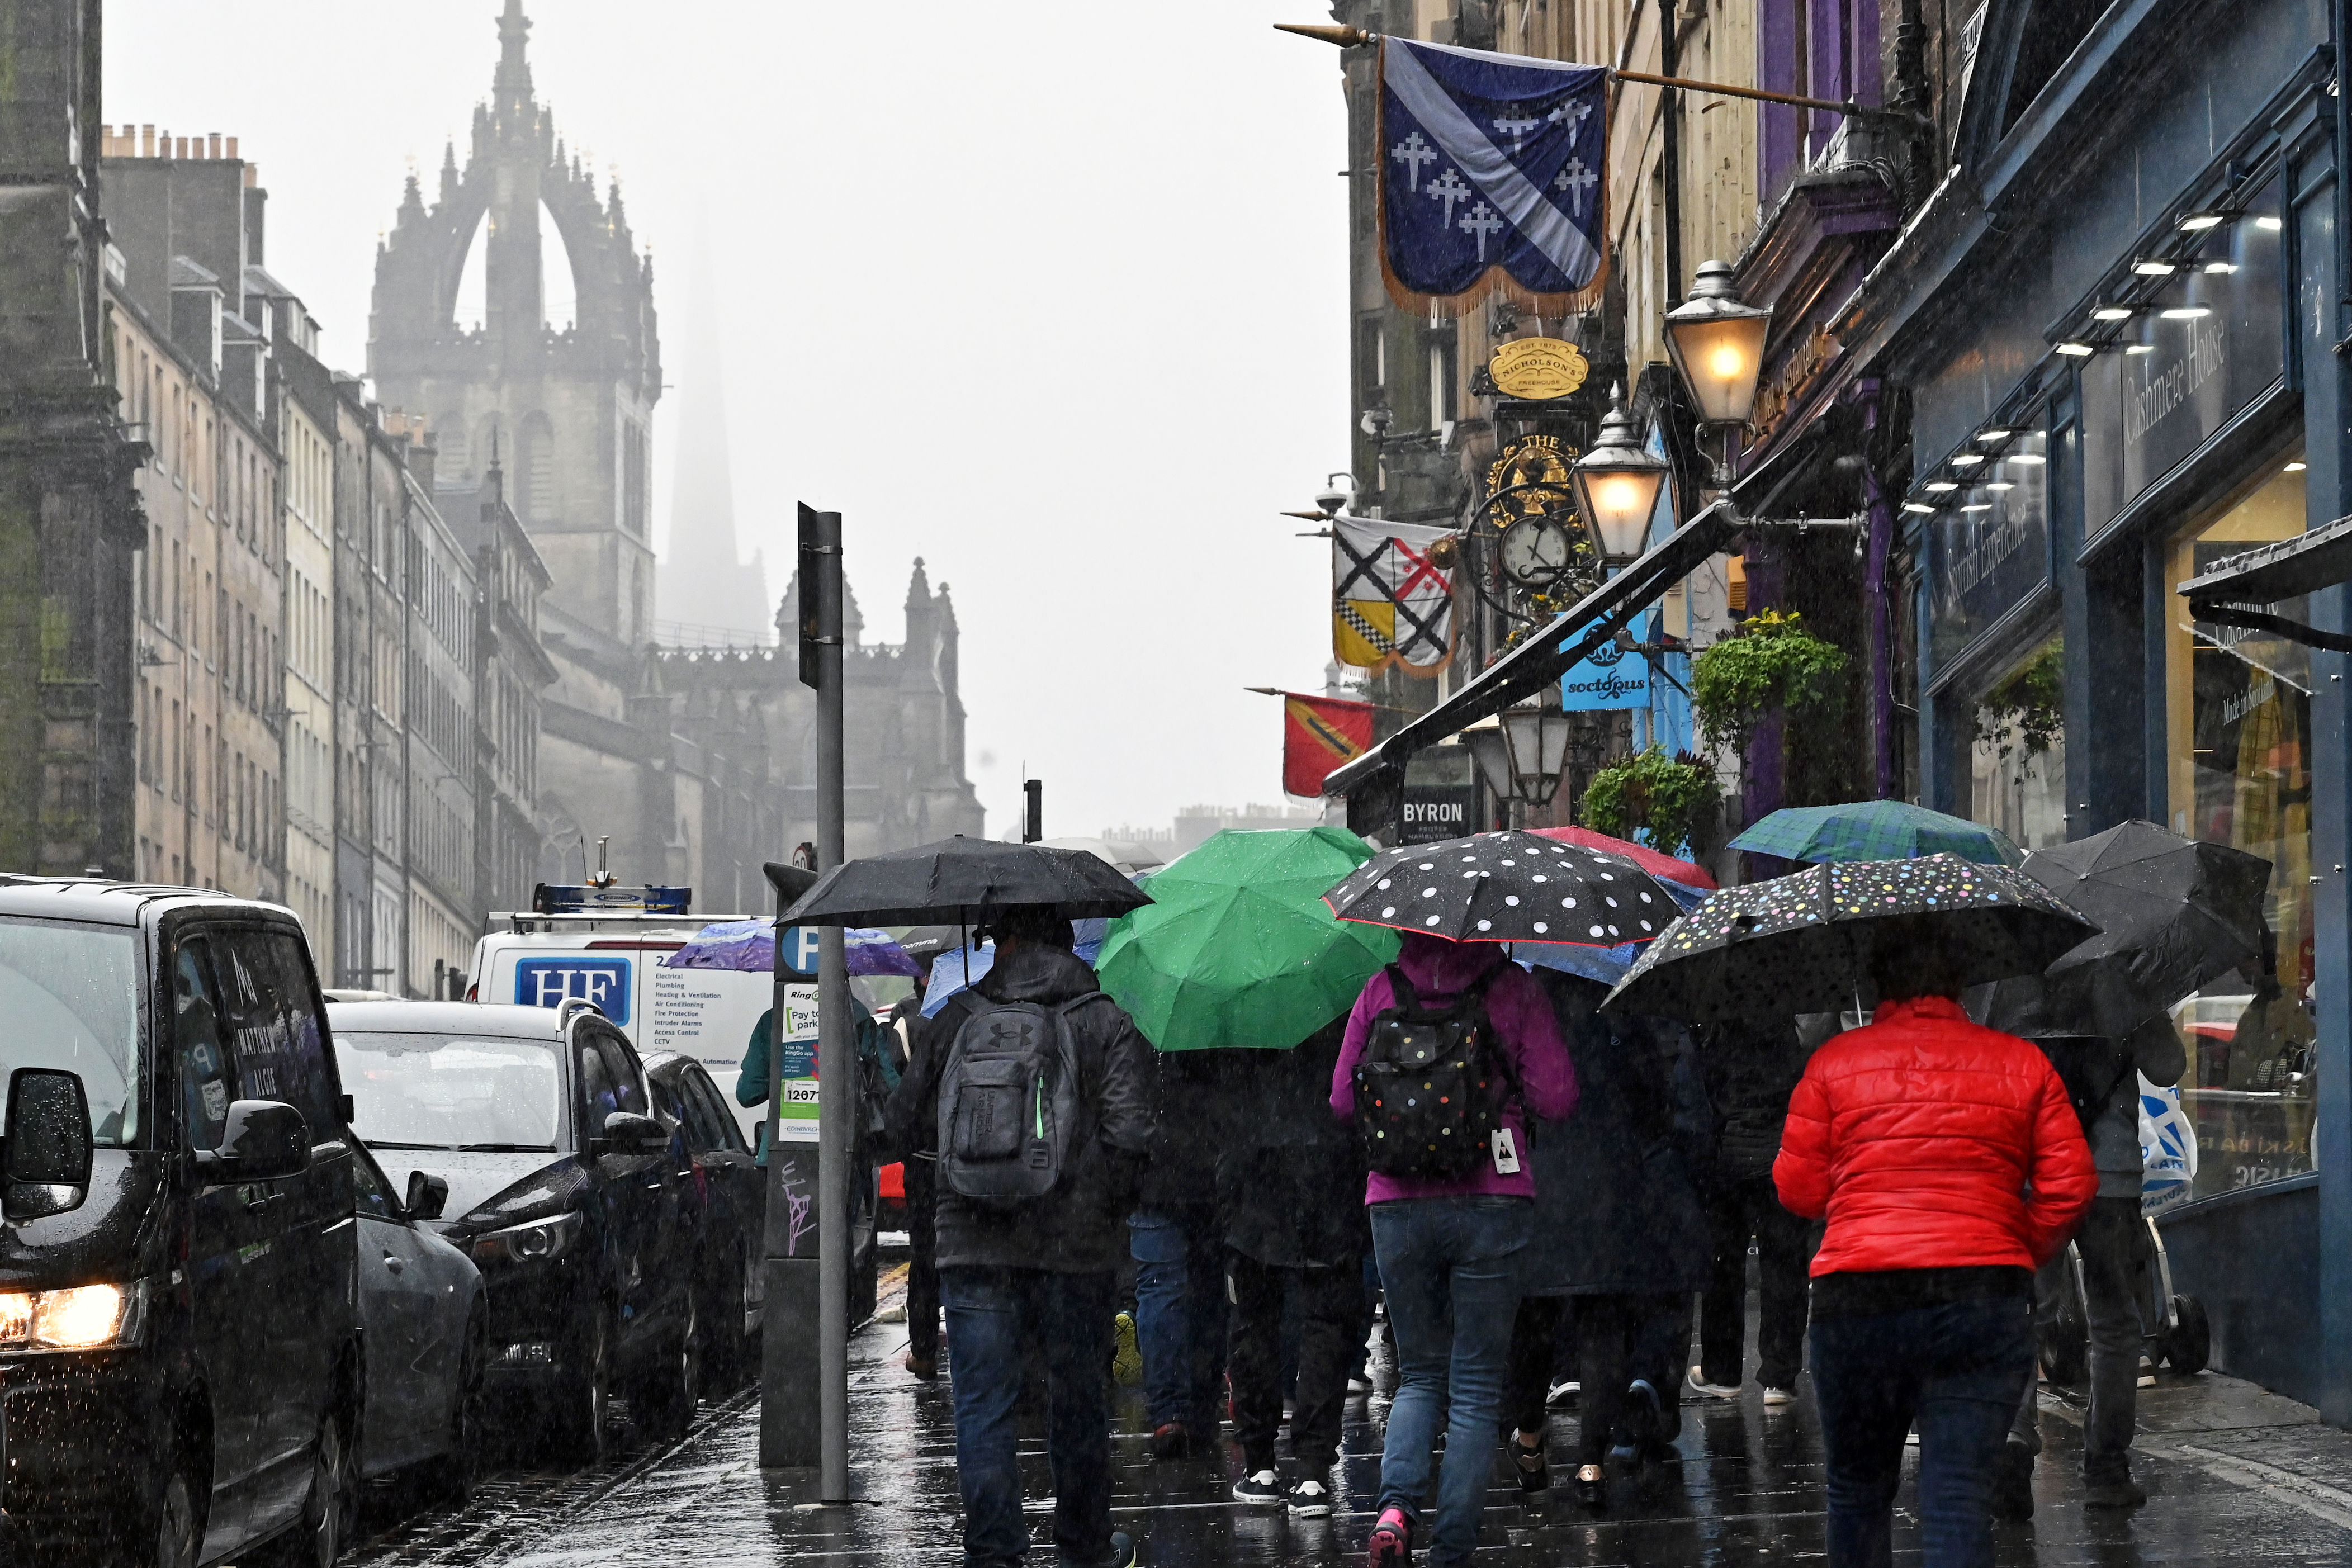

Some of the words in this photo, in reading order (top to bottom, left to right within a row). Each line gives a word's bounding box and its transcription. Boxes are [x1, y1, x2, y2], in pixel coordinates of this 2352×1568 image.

[1503, 359, 1576, 377] NICHOLSON'S
[2126, 358, 2184, 445] Cashmere
[2187, 318, 2224, 395] House
[1522, 435, 1560, 449] THE
[1948, 524, 1979, 603] Scottish
[1980, 503, 2026, 586] Experience
[1568, 669, 1645, 699] soctopus
[2223, 693, 2240, 726] Made
[2241, 689, 2247, 715] in
[1404, 803, 1462, 822] BYRON
[791, 991, 818, 1000] RingG
[792, 1011, 808, 1020] Pay
[797, 1019, 818, 1030] park
[238, 1025, 276, 1055] MATTHEW
[254, 1067, 276, 1096] ALGIE
